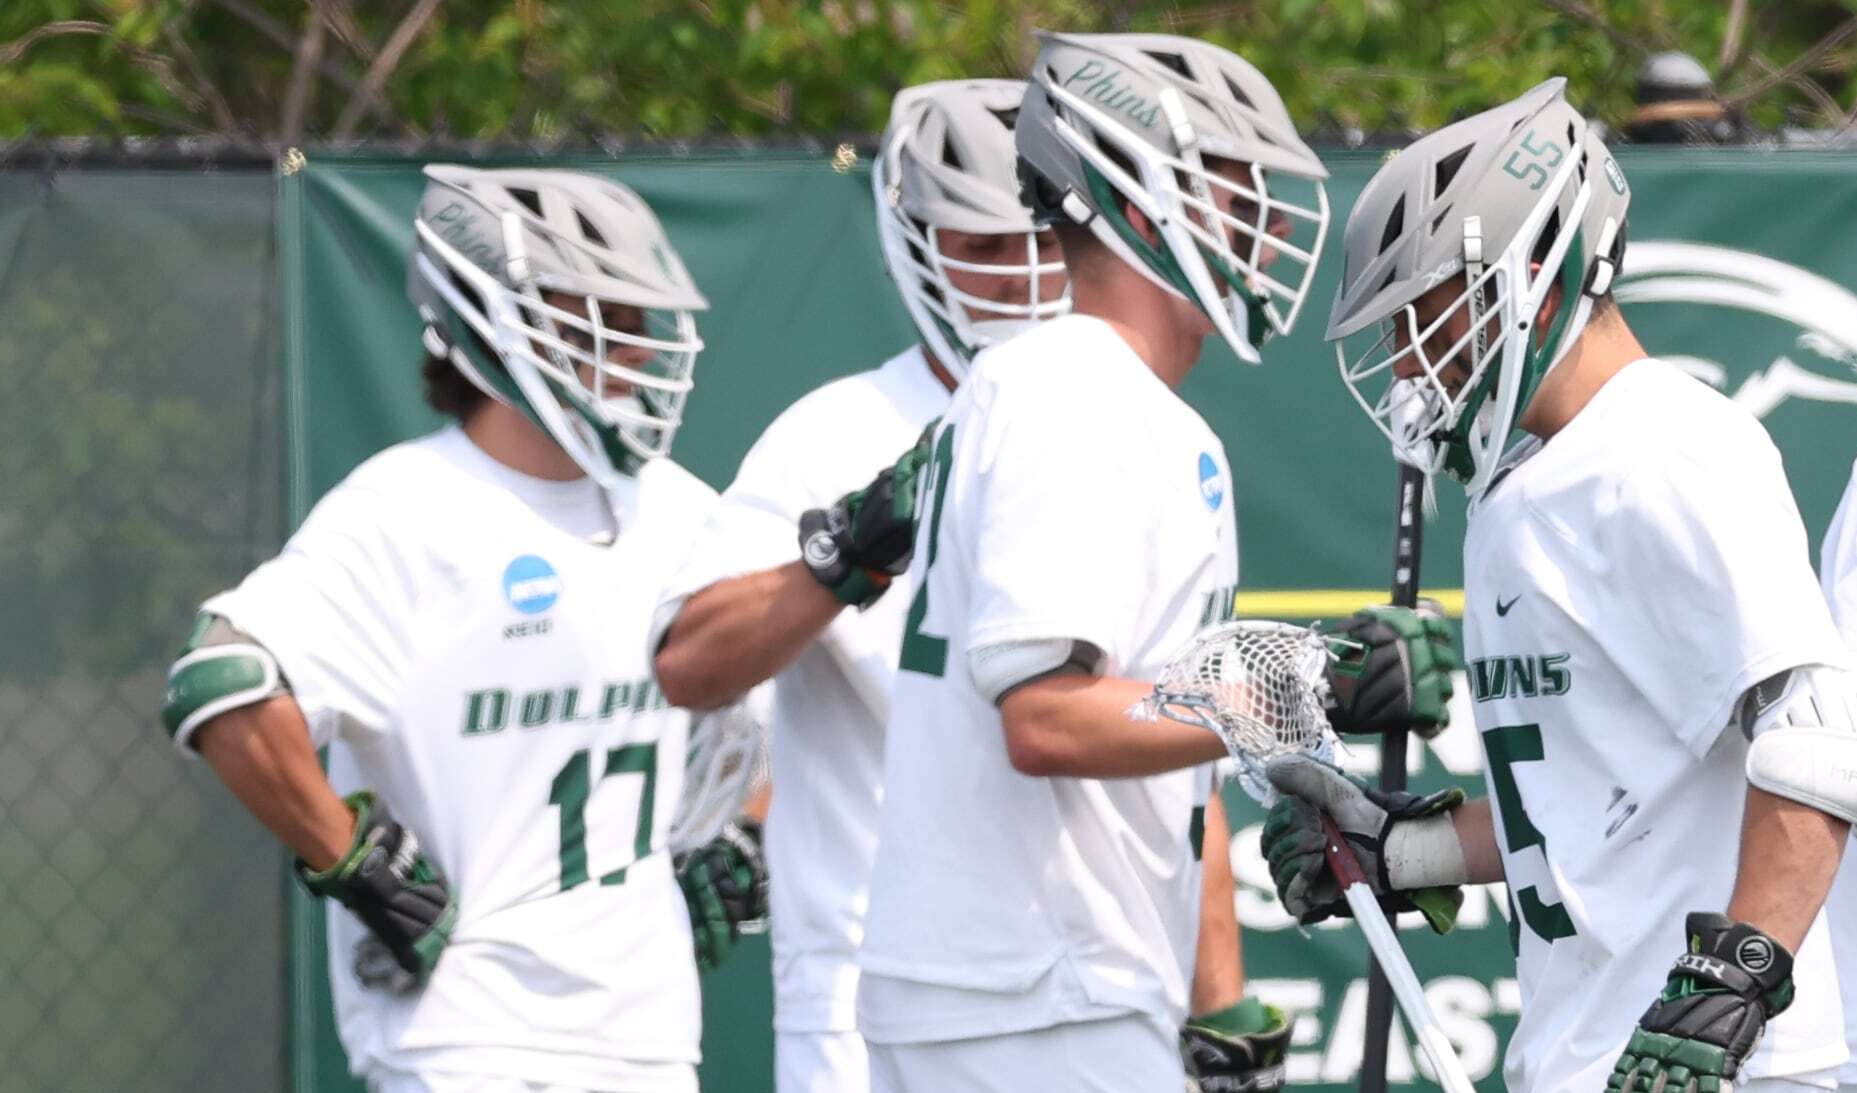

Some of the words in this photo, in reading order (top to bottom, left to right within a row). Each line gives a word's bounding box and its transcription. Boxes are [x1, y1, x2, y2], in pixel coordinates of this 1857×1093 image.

[1063, 61, 1161, 128] Phins
[1502, 130, 1564, 191] 55
[549, 741, 659, 892] 17
